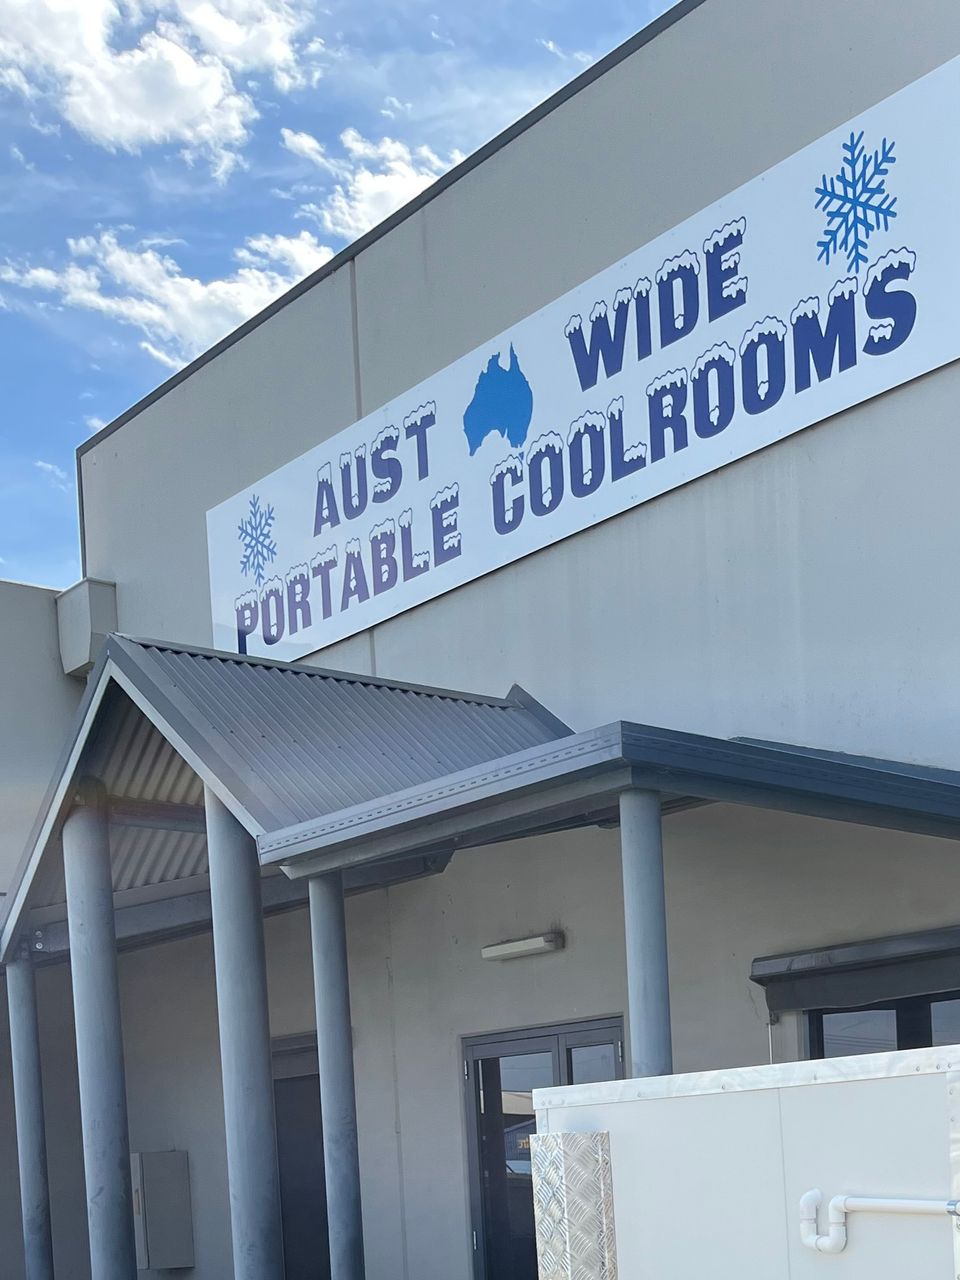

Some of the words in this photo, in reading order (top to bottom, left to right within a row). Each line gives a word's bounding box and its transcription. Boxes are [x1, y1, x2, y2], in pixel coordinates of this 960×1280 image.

[234, 482, 462, 655] PORTABLE
[490, 246, 917, 535] COOLROOMS
[313, 399, 436, 537] AUST
[563, 216, 748, 391] WIDE
